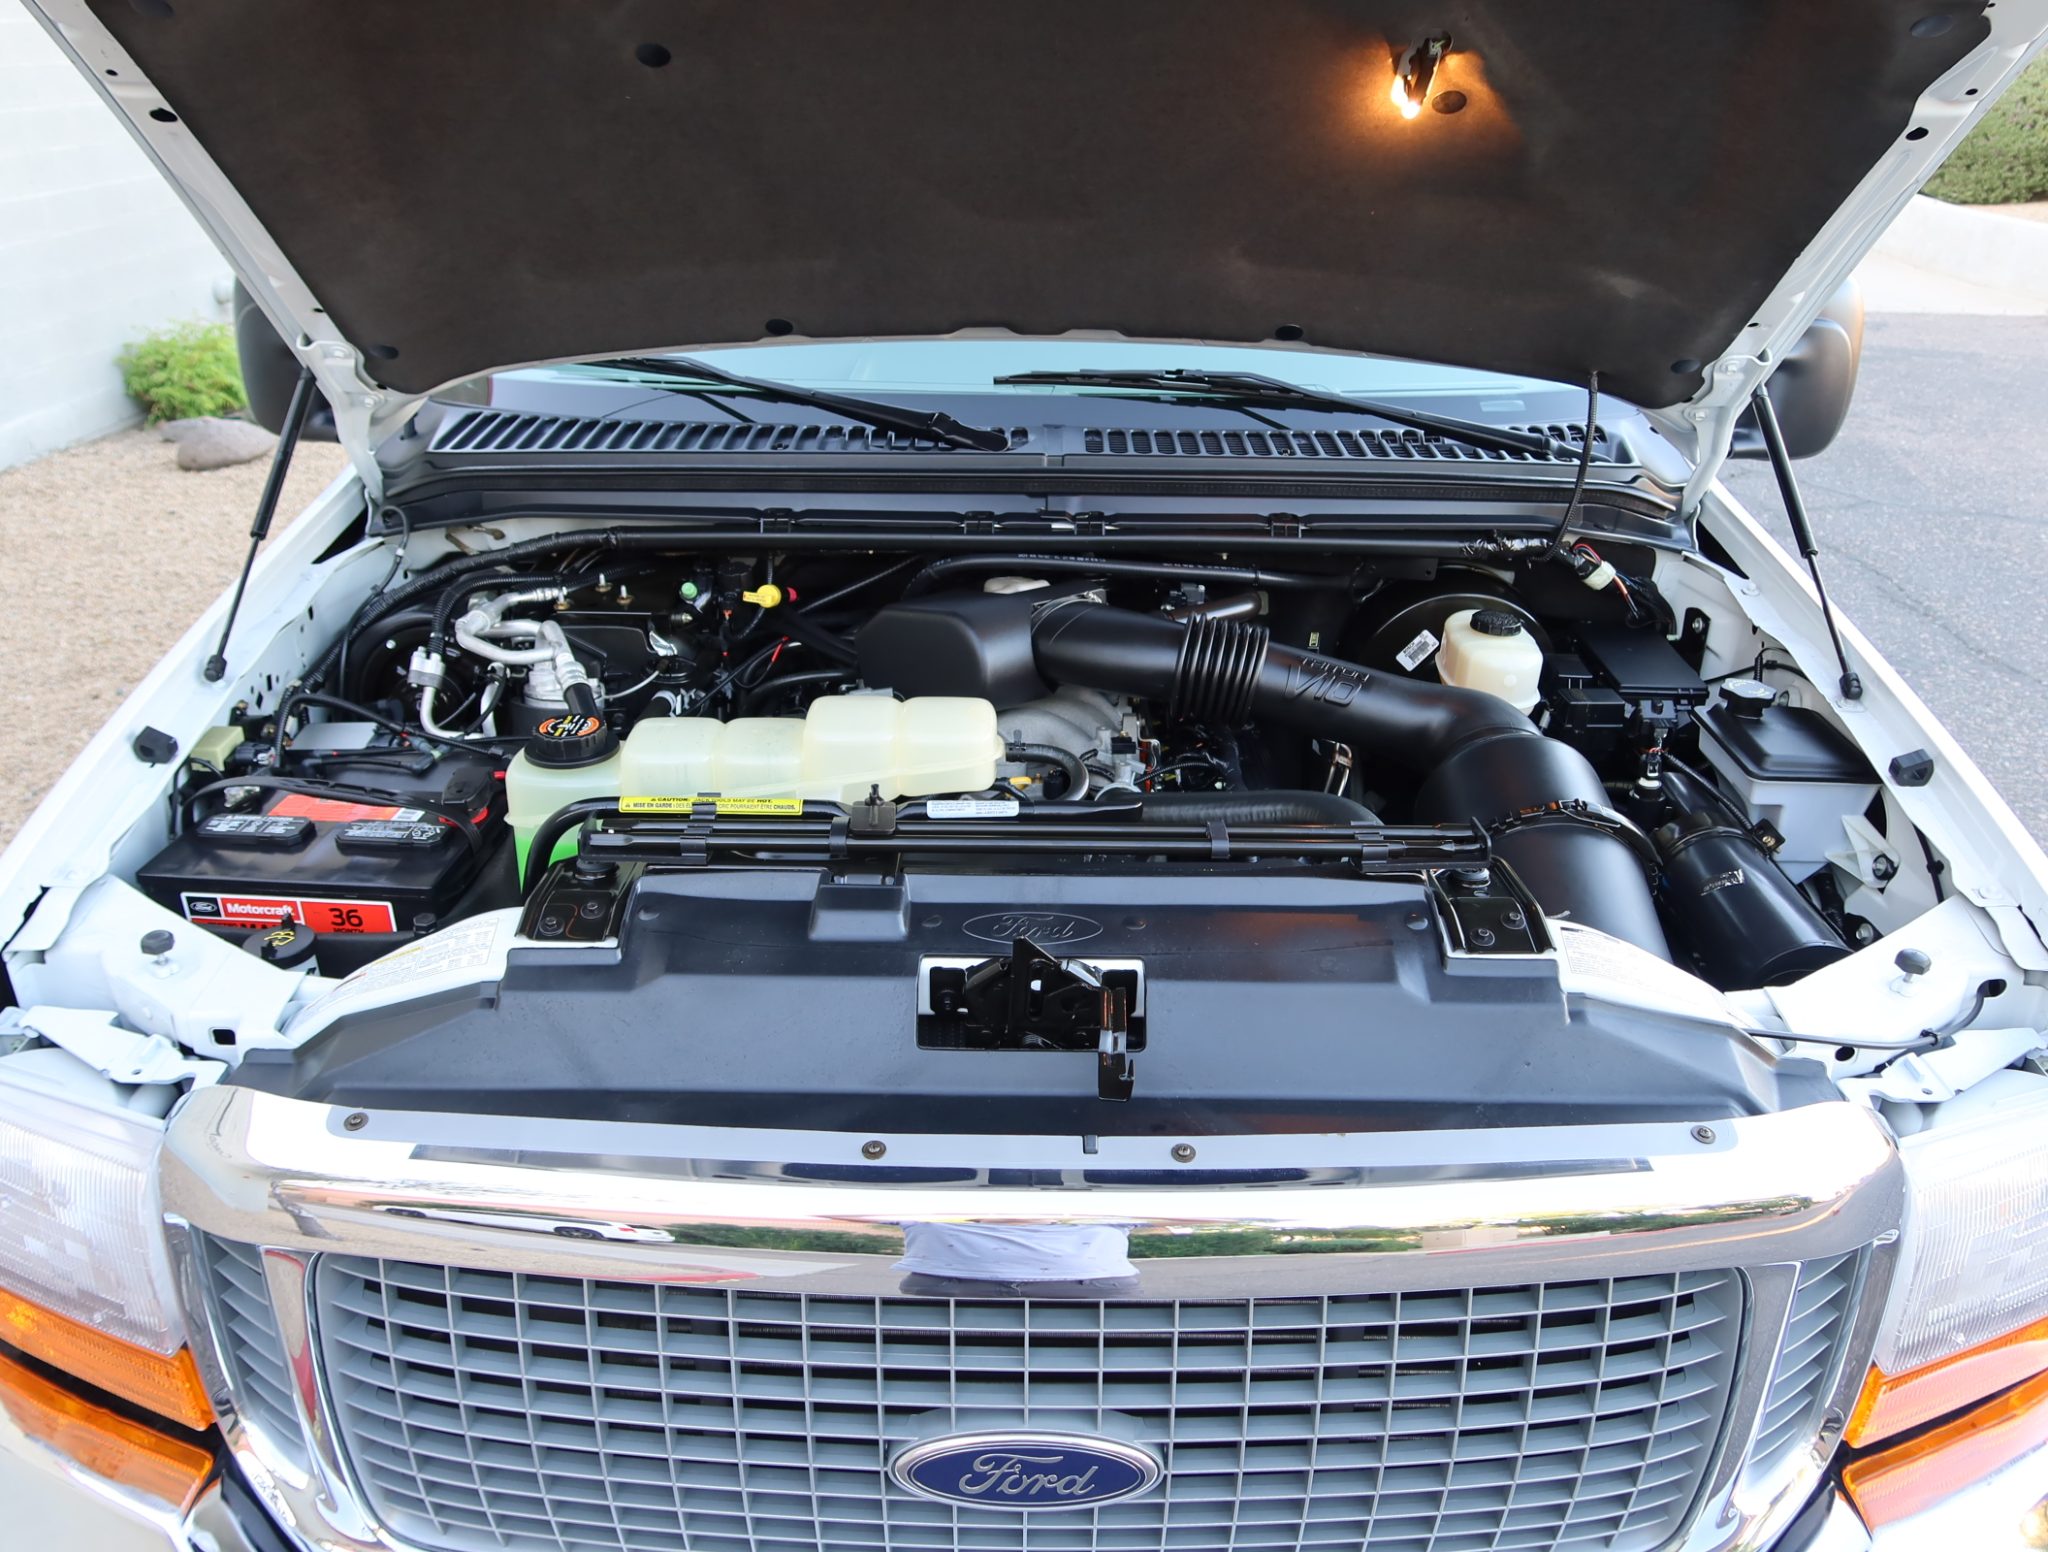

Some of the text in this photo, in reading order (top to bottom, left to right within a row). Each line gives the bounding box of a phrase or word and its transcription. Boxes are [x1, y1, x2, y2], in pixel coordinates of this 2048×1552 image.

[1284, 664, 1363, 707] V10
[226, 903, 293, 916] Motorcraft
[328, 907, 364, 927] 36
[992, 915, 1075, 938] Ford
[958, 1452, 1099, 1496] Ford
